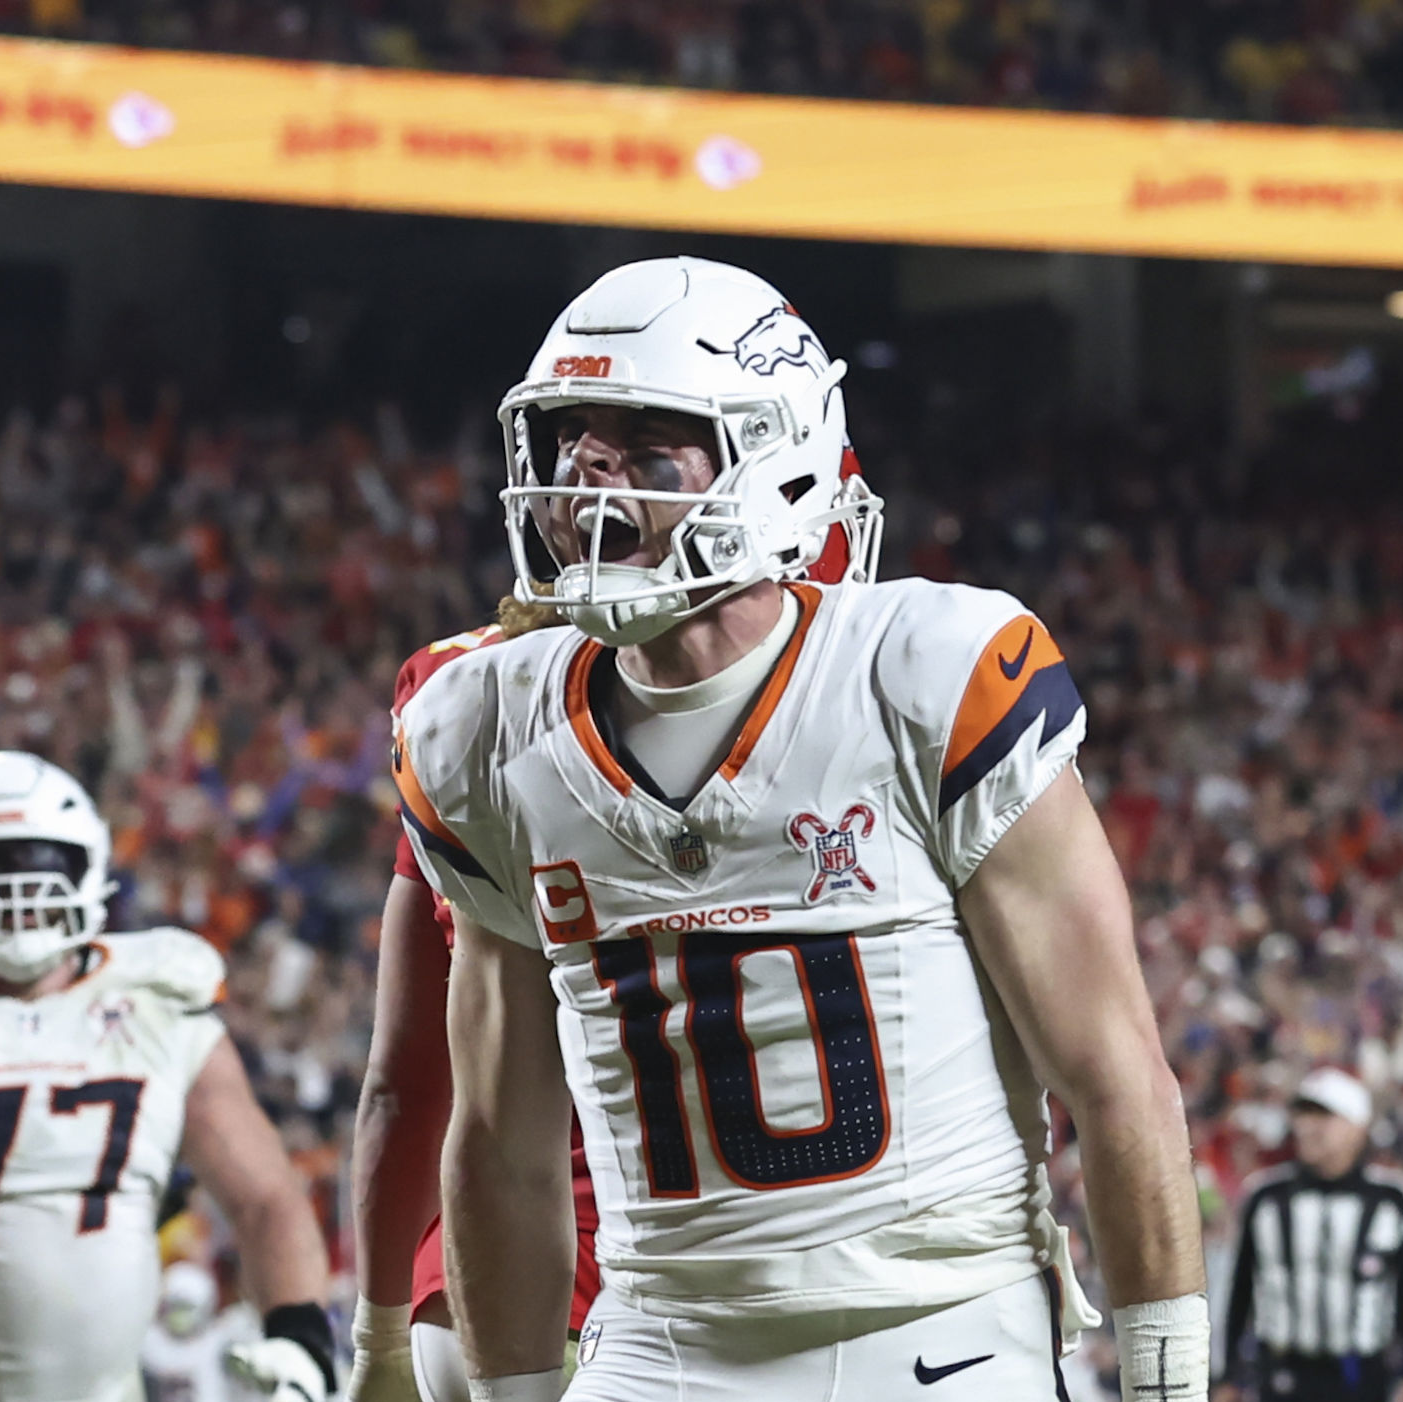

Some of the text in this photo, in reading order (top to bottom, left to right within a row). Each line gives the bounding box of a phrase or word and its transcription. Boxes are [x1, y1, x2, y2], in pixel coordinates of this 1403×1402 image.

[821, 848, 855, 871] NFL
[534, 868, 586, 924] C
[625, 905, 771, 935] BRONCOS
[588, 930, 891, 1199] 10
